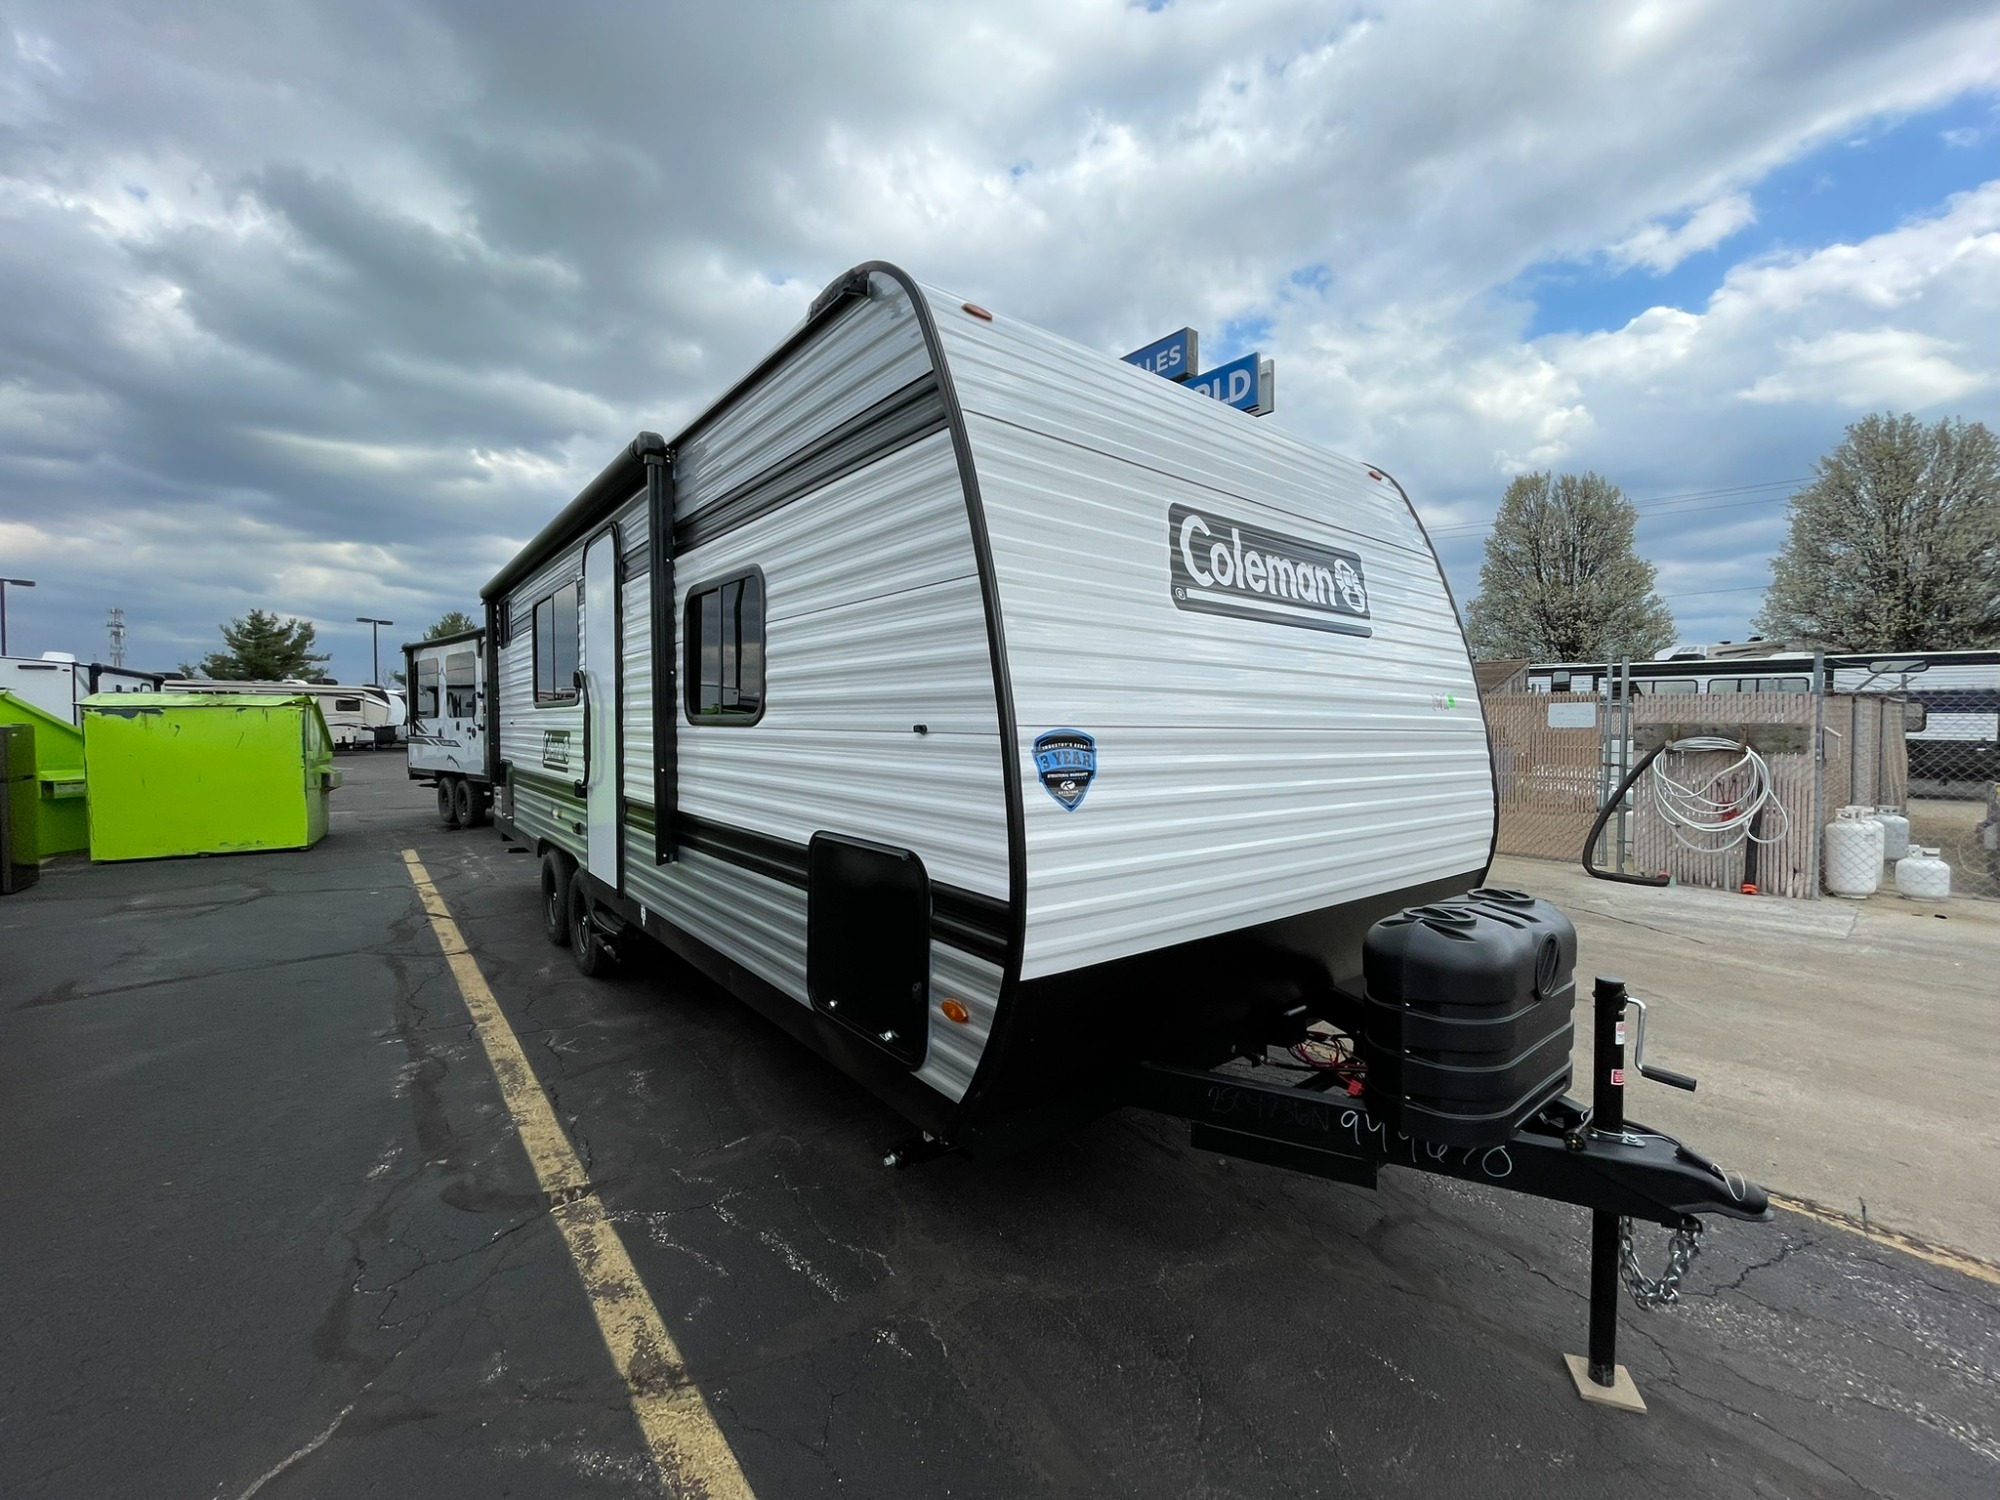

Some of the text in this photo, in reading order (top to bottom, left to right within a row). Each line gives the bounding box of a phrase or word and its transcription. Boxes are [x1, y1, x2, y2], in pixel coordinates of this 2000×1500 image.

[1136, 345, 1181, 373] LES
[1179, 514, 1338, 607] Coleman
[1041, 750, 1091, 769] 3 YEAR
